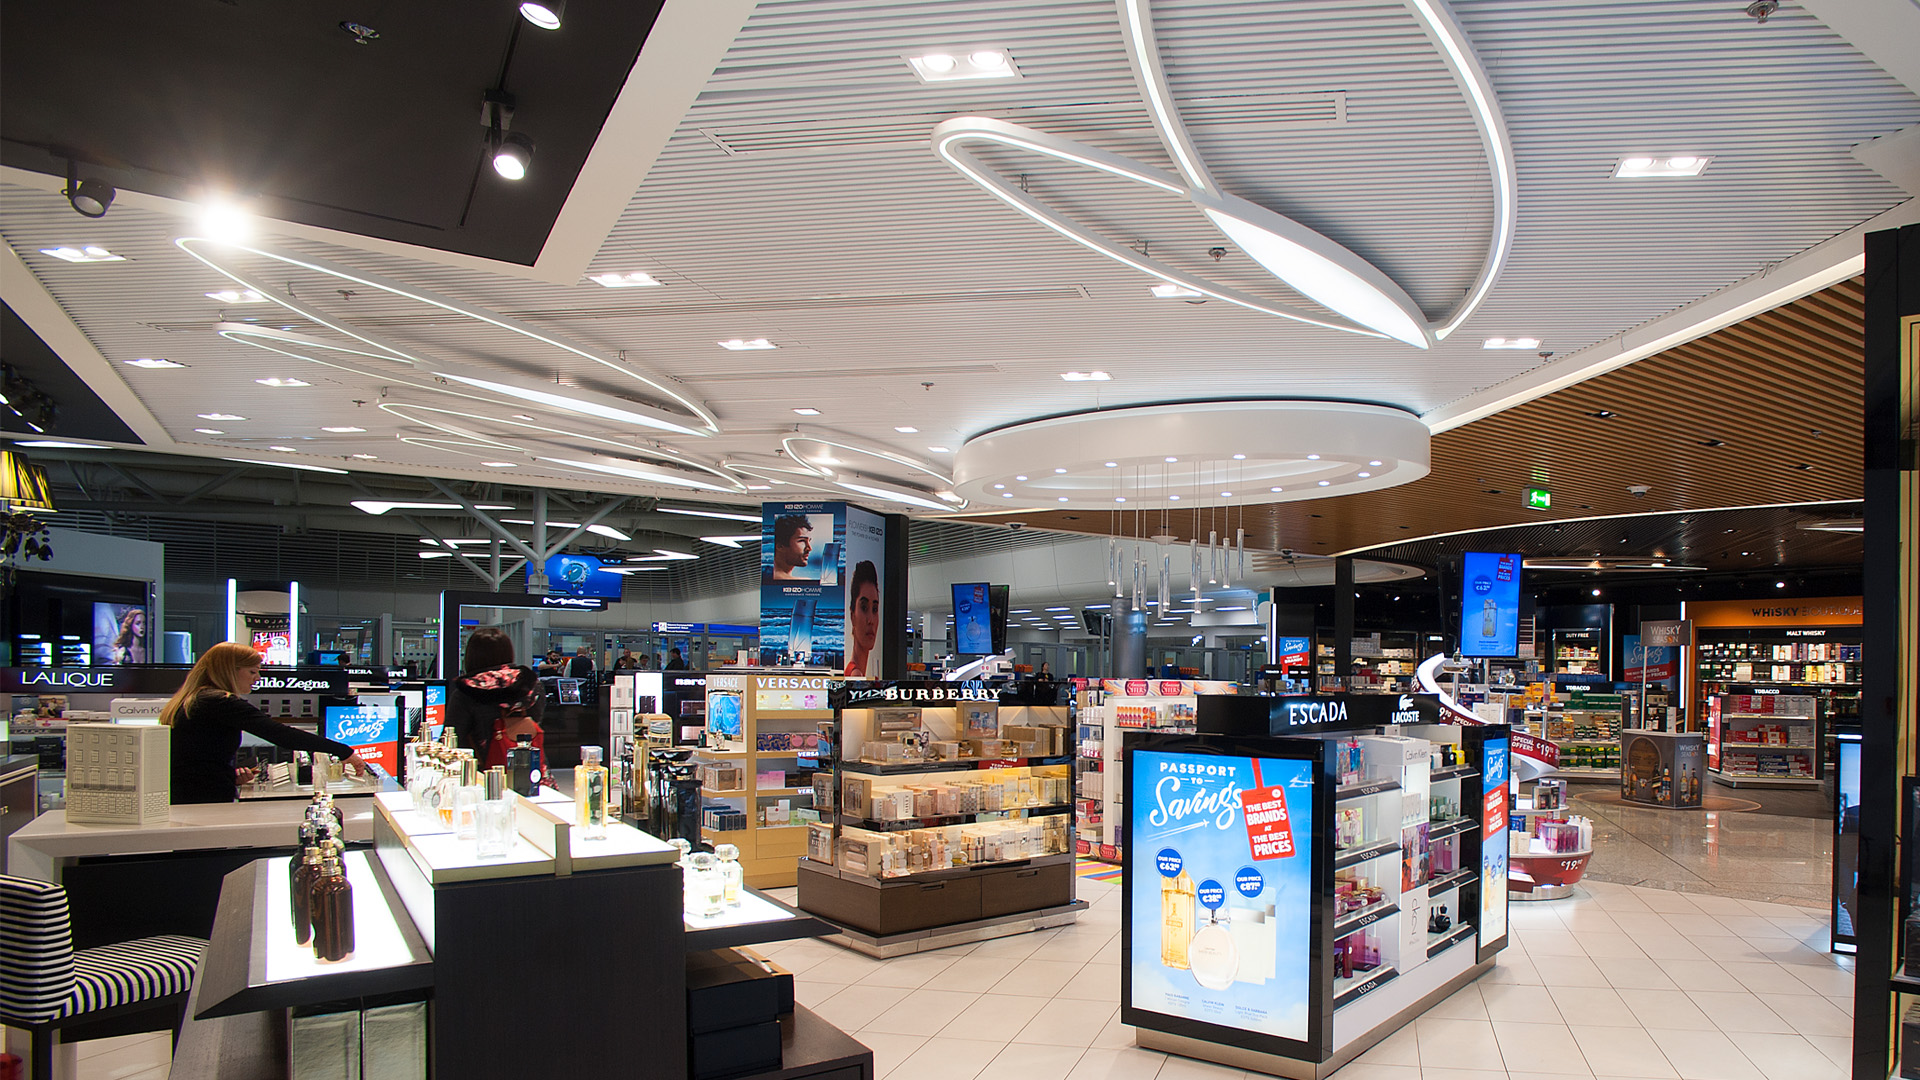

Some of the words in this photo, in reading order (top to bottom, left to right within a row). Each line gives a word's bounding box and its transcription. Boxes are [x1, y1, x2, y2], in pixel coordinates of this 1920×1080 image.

[1650, 625, 1681, 636] WHISKY
[21, 671, 114, 688] LALIQUE
[286, 677, 329, 691] Zegna
[713, 677, 738, 688] VERSACE
[884, 688, 1002, 701] BURBERRY
[118, 706, 149, 715] Calvin
[1289, 701, 1348, 725] ESCADA
[1391, 710, 1420, 724] LACOSTE
[334, 719, 385, 740] Savings
[1511, 742, 1534, 751] OFFERS
[1512, 735, 1534, 746] SPECIAL
[1160, 762, 1236, 777] PASSPORT
[1190, 777, 1203, 785] TO
[1150, 775, 1243, 831] Savings
[1246, 803, 1262, 813] THE
[1262, 799, 1282, 811] BEST
[1246, 808, 1287, 826] BRANDS
[1252, 834, 1269, 843] THE
[1269, 831, 1289, 841] BEST
[1254, 840, 1292, 857] PRICES
[1358, 914, 1378, 925] ESCADA
[1357, 981, 1378, 994] ESCADA
